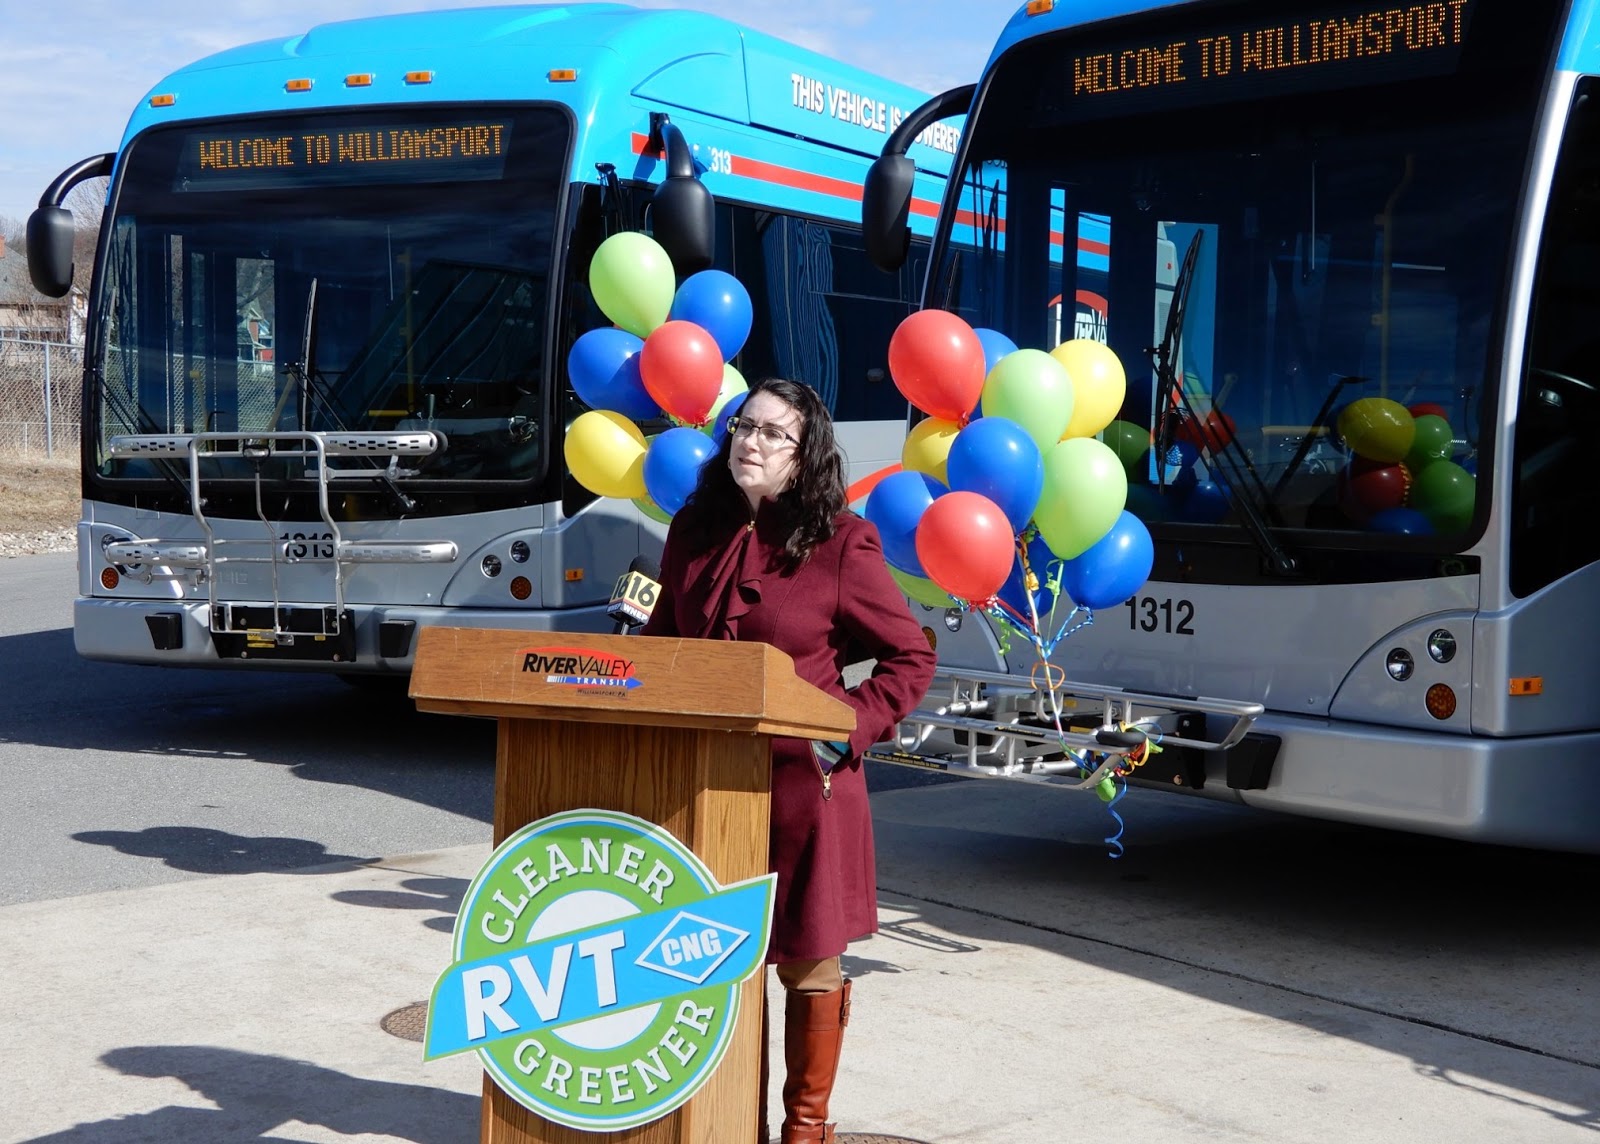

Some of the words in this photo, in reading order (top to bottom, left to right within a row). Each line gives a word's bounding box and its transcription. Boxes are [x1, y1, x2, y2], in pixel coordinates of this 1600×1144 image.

[1074, 41, 1187, 96] WELCOME
[1198, 35, 1232, 78] TO
[1242, 0, 1468, 72] WILLIAMSPORT
[791, 73, 824, 115] THIS
[827, 84, 887, 134] VEHICLE
[200, 136, 295, 169] WELCOME
[302, 134, 331, 165] TO
[338, 124, 505, 163] WILLIAMSPORT
[279, 532, 335, 559] 1313
[623, 602, 650, 622] WNEP
[628, 575, 656, 607] 16
[1124, 595, 1195, 636] 1312
[576, 677, 627, 686] TRANSIT
[481, 837, 675, 944] CLEANER
[660, 928, 723, 967] CNG
[461, 929, 626, 1041] RVT
[512, 999, 715, 1105] GREENER
